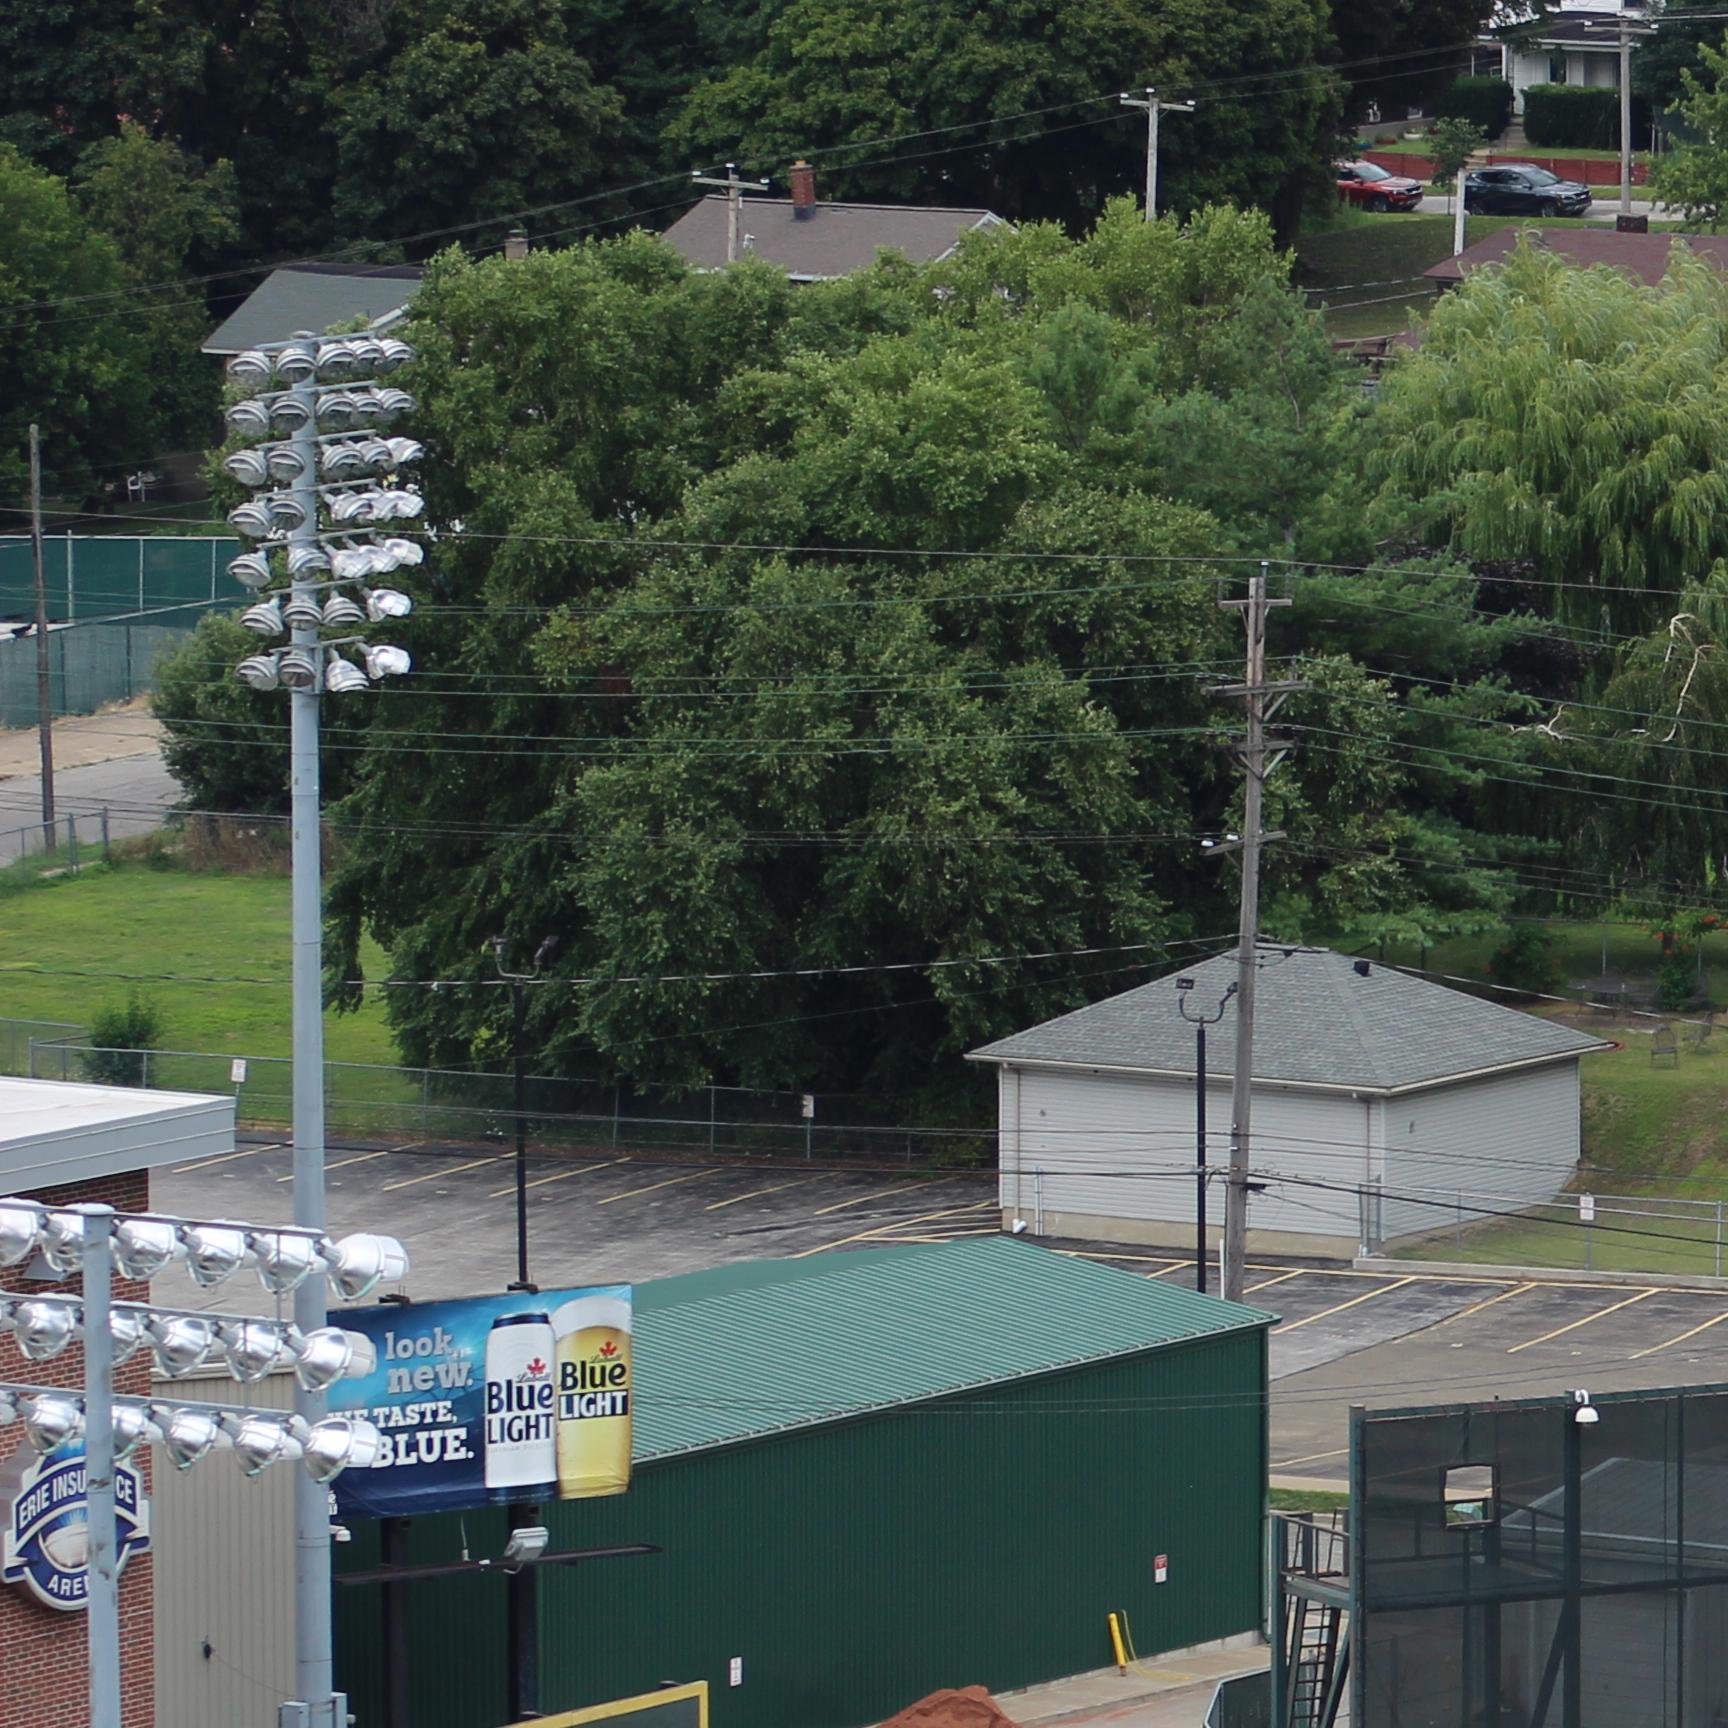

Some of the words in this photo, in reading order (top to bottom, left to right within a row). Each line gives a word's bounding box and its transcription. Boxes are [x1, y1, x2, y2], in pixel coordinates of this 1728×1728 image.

[387, 1361, 473, 1394] new.
[560, 1360, 626, 1391] Blue
[487, 1379, 553, 1414] Blue
[560, 1391, 627, 1419] LIGHT
[373, 1401, 458, 1428] TASTE,
[487, 1413, 554, 1444] LIGHT
[371, 1427, 475, 1468] BLUE.
[19, 1488, 50, 1529] ERIE
[52, 1469, 134, 1505] INSUCE
[48, 1574, 89, 1596] ARE
